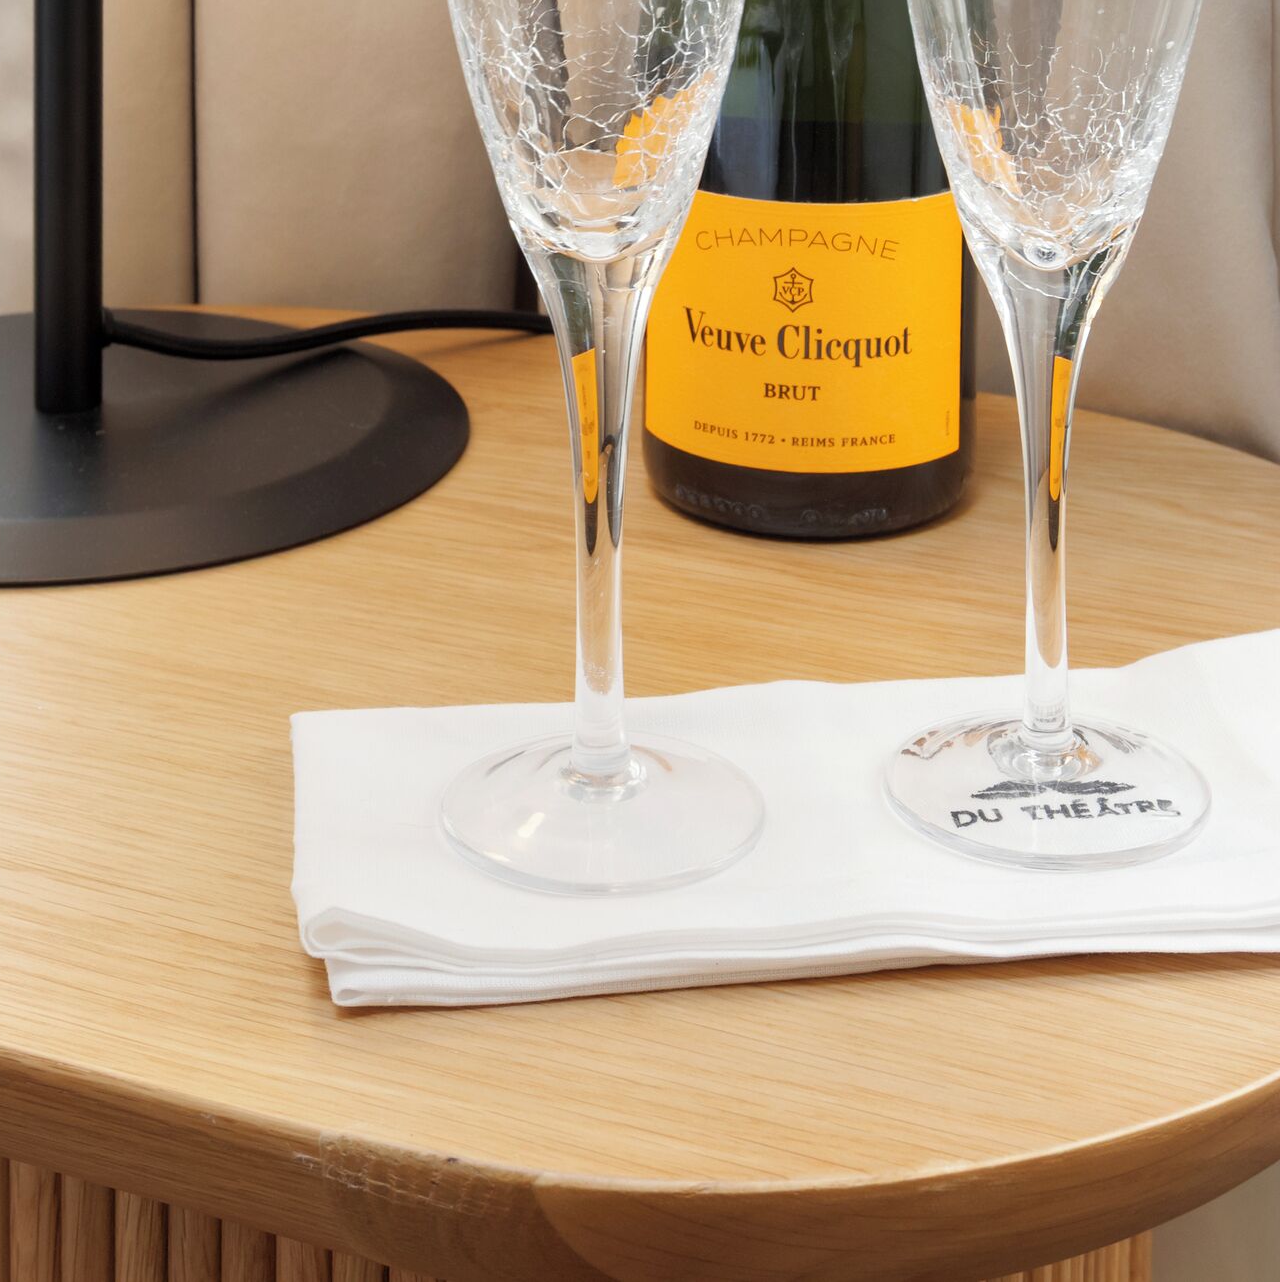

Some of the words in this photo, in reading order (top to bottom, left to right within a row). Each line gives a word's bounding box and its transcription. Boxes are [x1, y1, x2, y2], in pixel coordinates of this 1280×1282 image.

[695, 227, 900, 261] CHAMPAGNE
[683, 306, 767, 356] Veuve
[776, 324, 913, 369] Clicquot
[763, 382, 821, 402] BRUT
[693, 420, 739, 440] DEPUIS
[744, 431, 776, 445] 1772
[791, 436, 835, 448] REIMS
[841, 433, 896, 448] FRANCE
[950, 808, 1004, 828] DU
